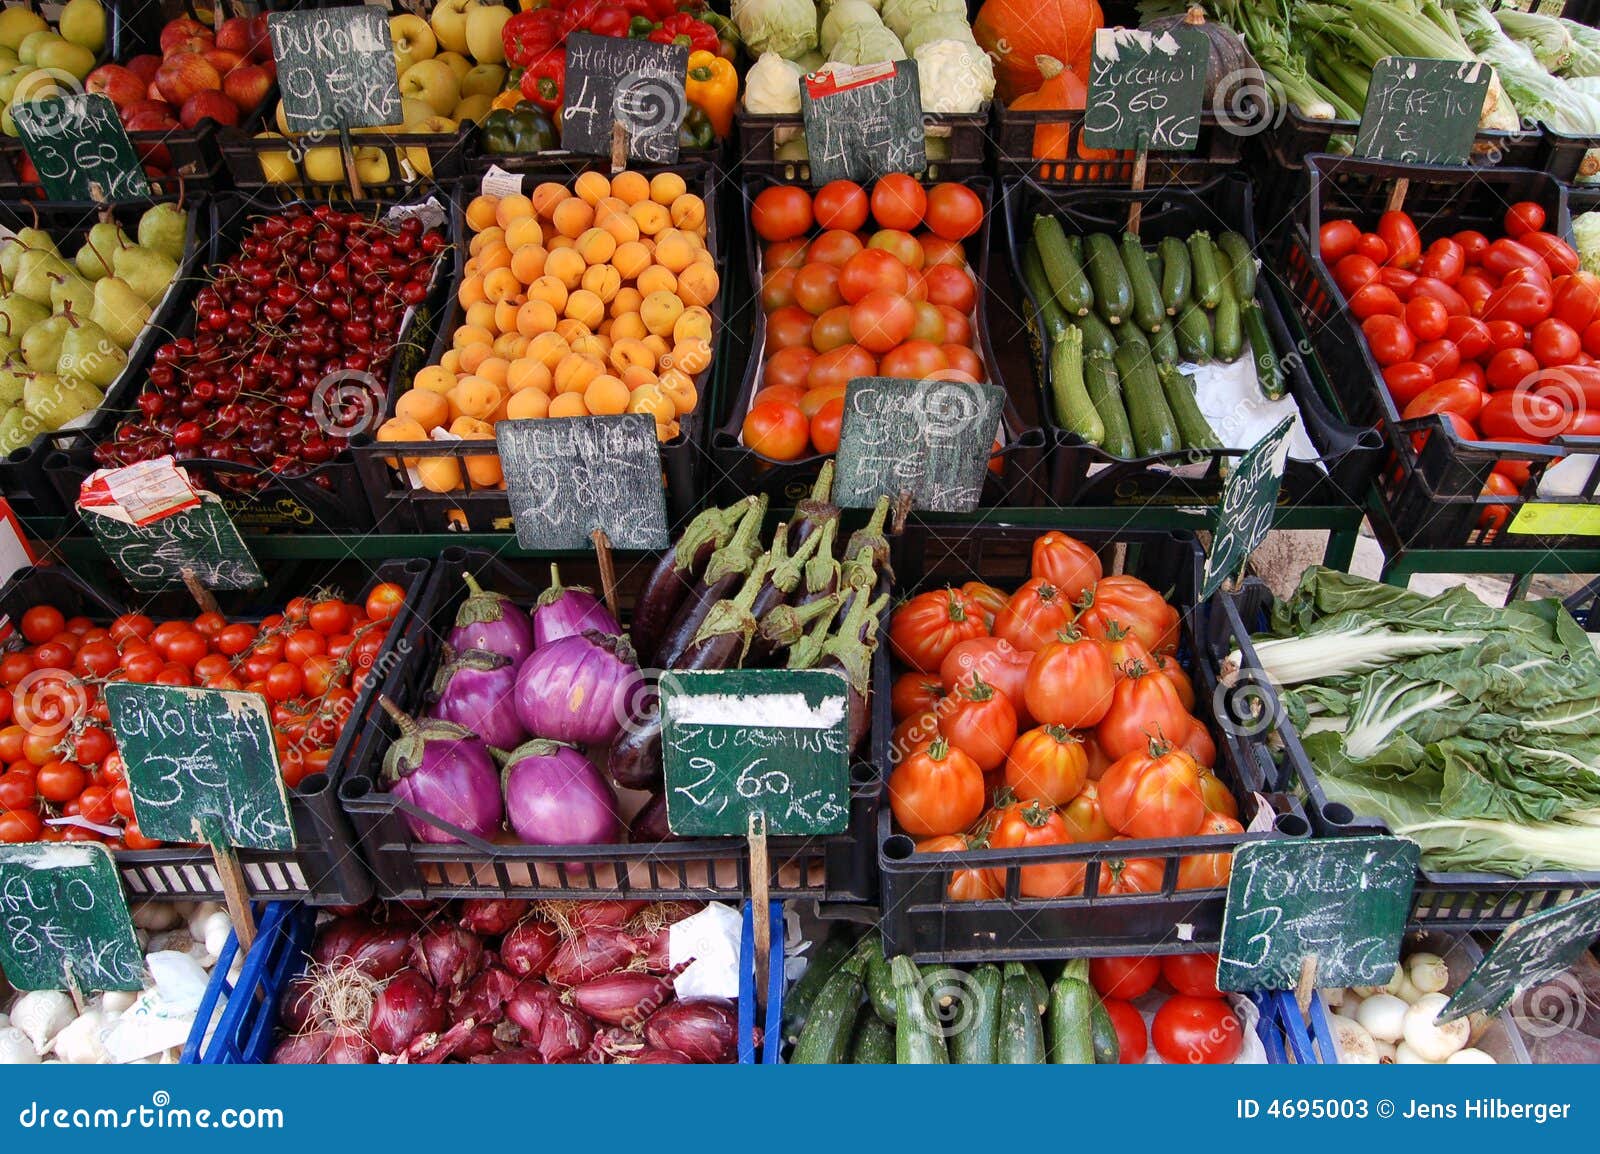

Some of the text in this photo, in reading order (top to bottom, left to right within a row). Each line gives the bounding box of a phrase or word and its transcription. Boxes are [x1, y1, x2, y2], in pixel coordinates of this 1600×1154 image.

[1152, 115, 1199, 147] KG
[38, 140, 118, 184] 3,60
[675, 757, 790, 817] 2,60
